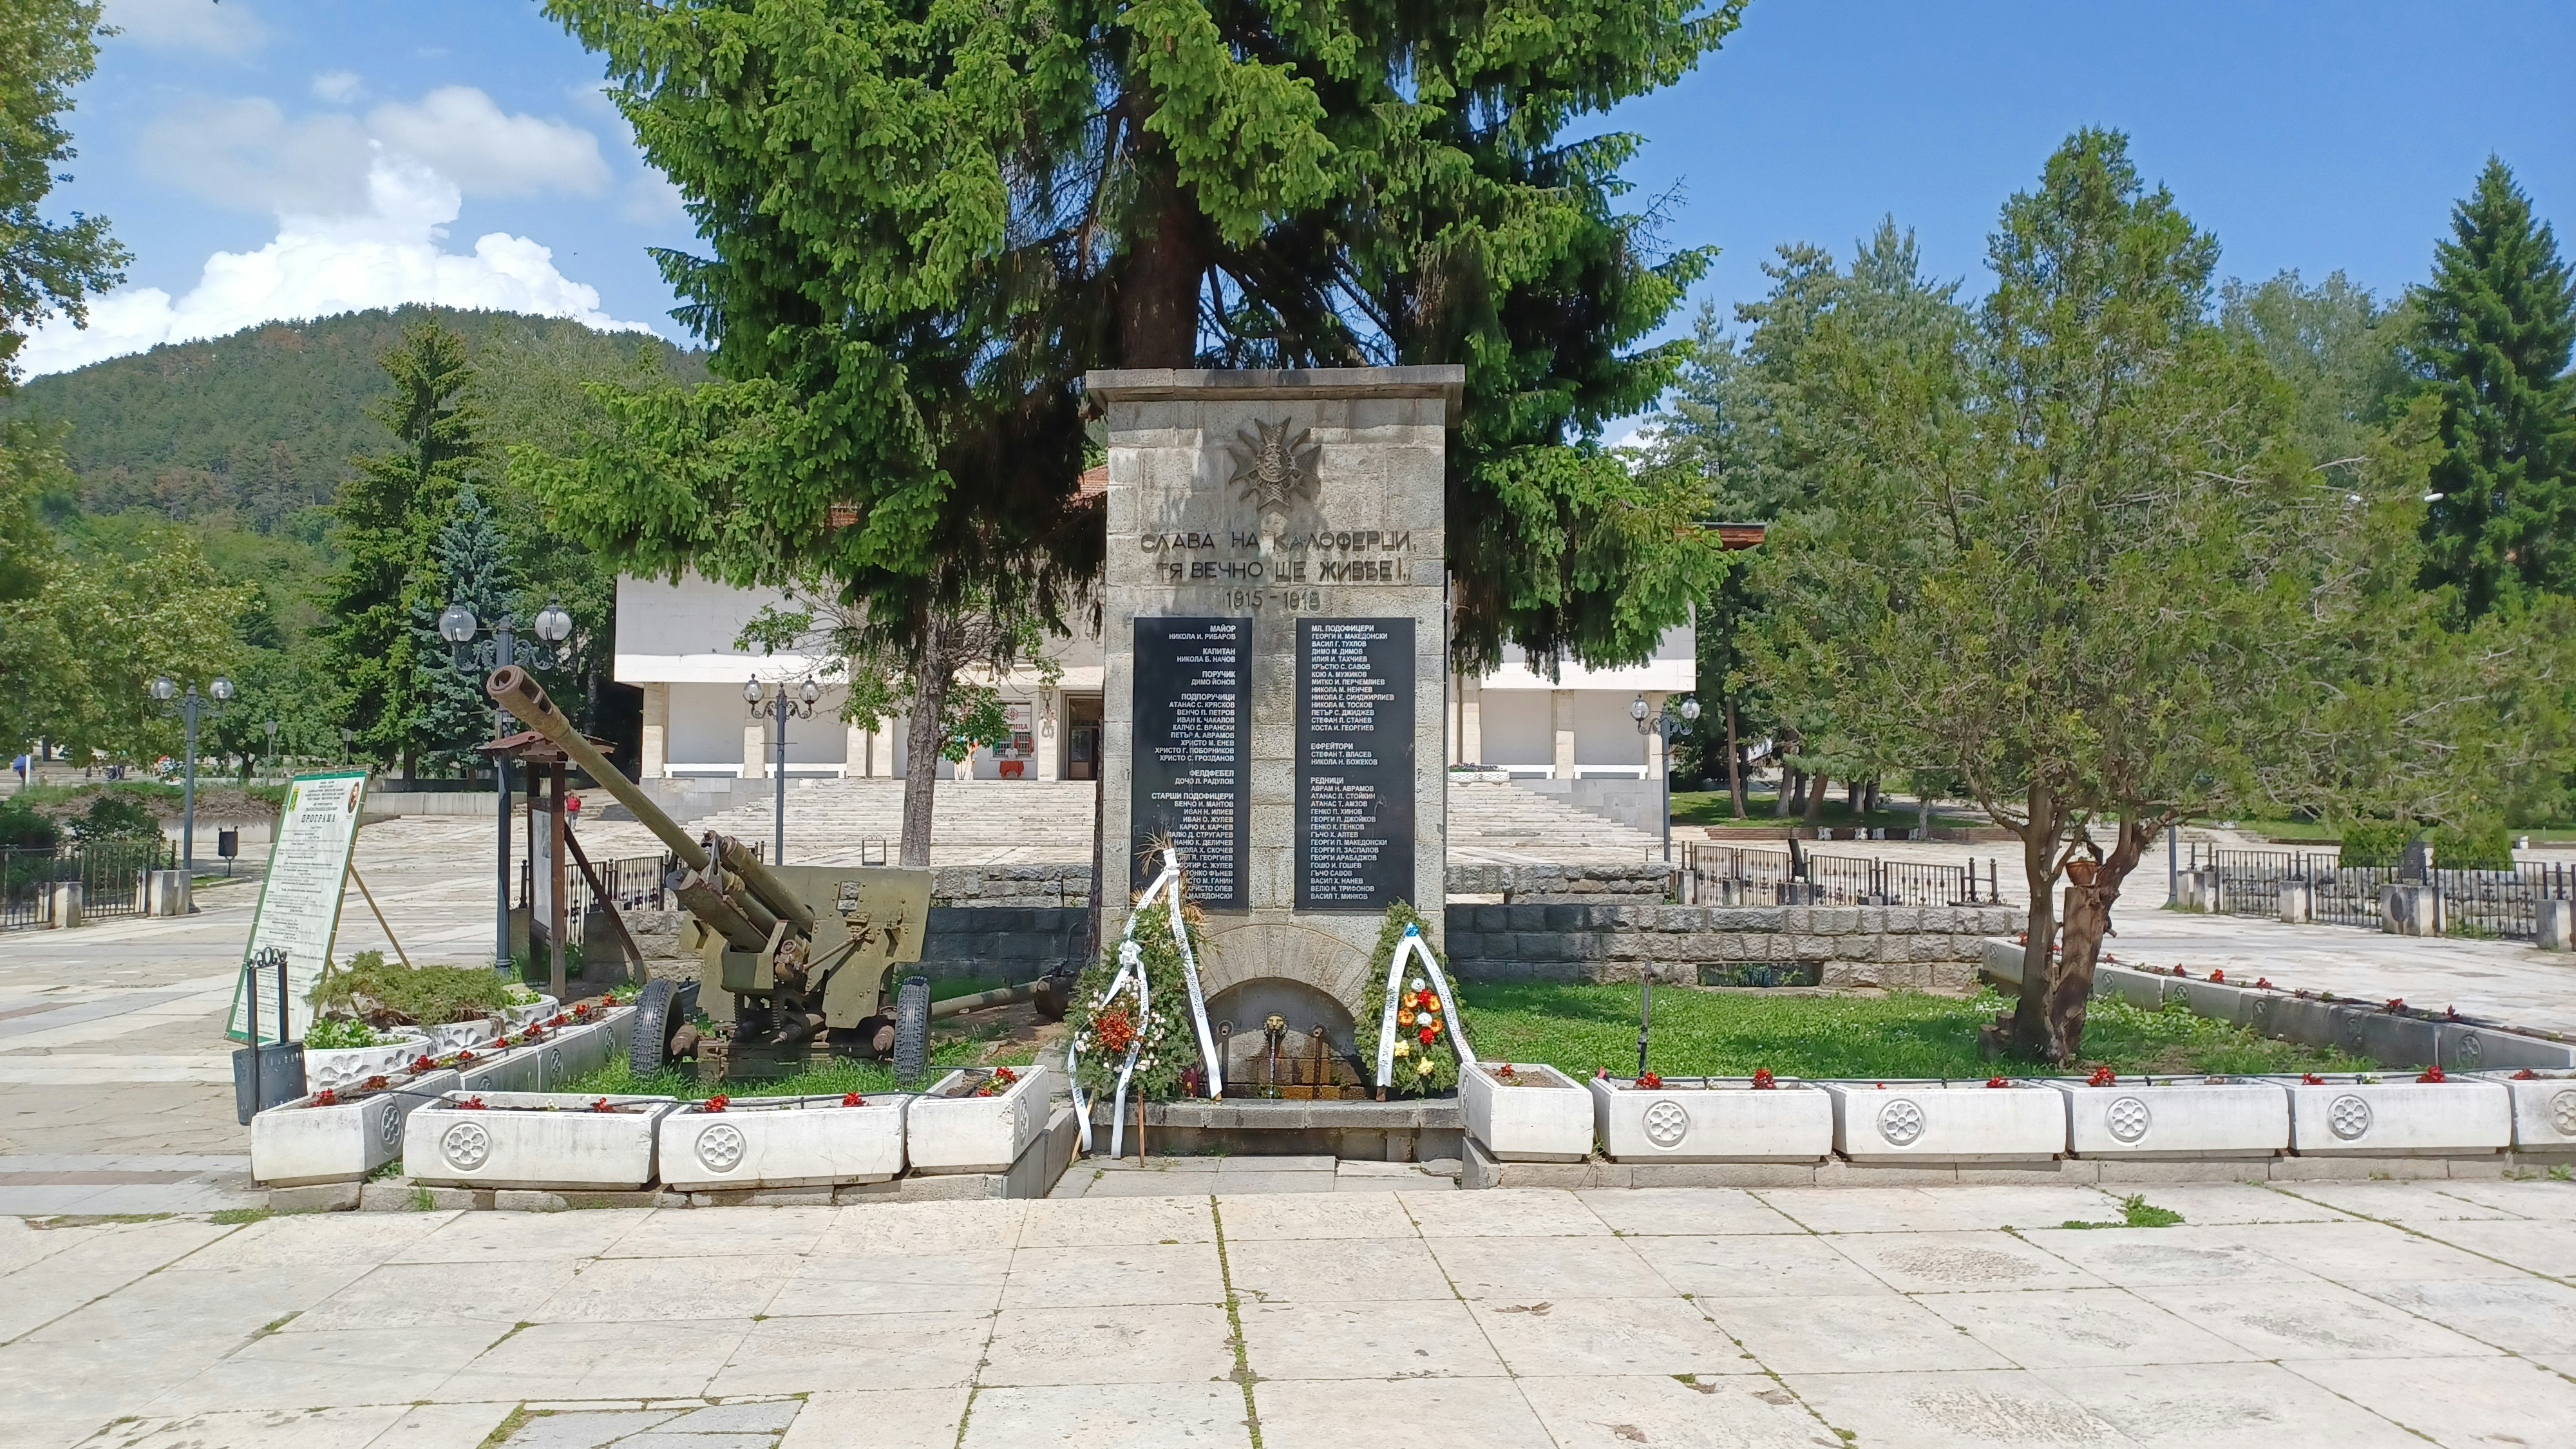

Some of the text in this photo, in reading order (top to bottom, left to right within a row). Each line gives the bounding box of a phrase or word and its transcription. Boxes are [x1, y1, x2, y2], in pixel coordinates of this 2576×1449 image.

[1141, 532, 1215, 554] СЛАВА
[1231, 531, 1260, 551] НА
[1156, 562, 1183, 583] ТЯ
[1191, 561, 1264, 580] ВЕЧНО
[1274, 560, 1307, 583] ЩЕ
[1226, 590, 1264, 611] 1915
[1283, 590, 1321, 612] 1918
[1210, 625, 1236, 633] МАЙОР
[1311, 625, 1374, 633] МЛ. ПОДОФИЦЕРИ
[1181, 693, 1235, 701] ПОДПОРУЧИЦИ
[1311, 742, 1353, 750] ЕФРЕЙТОРИ
[1189, 770, 1234, 778] ФЕЛДФЕБЕЛ
[1311, 777, 1343, 785] РЕДНИЦИ
[1151, 792, 1234, 800] СТАРШИ ПОДОФИЦЕРИ
[301, 813, 336, 823] ПРОГРАМА
